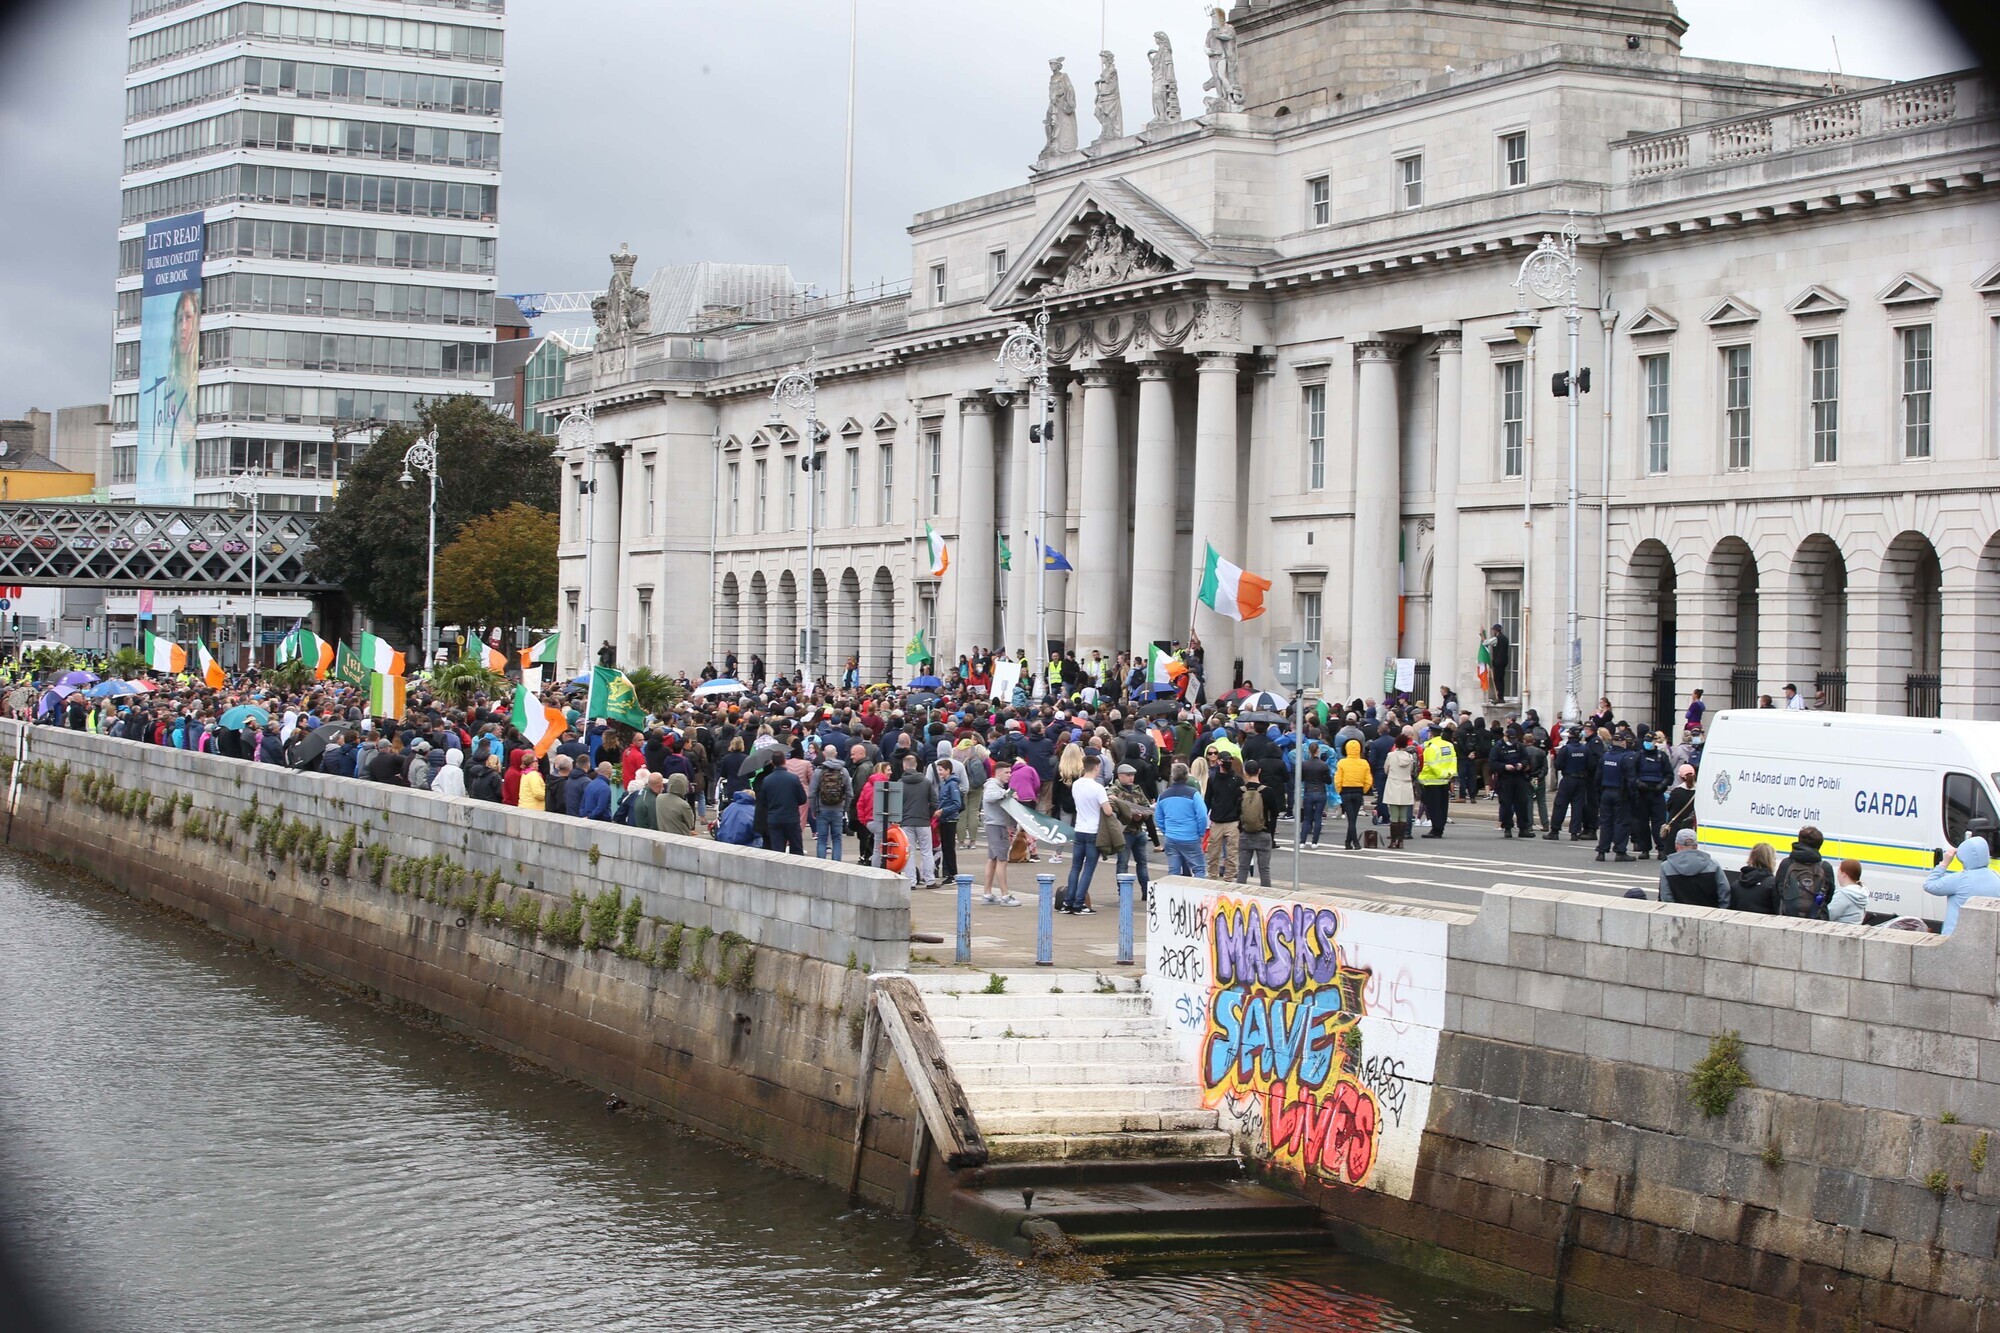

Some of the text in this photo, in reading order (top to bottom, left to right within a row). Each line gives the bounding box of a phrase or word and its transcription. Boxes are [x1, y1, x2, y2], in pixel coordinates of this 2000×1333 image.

[148, 225, 201, 251] LET'S READ!
[146, 249, 200, 270] DUBLIN ONE CITY
[155, 269, 188, 286] ONE BOOK
[1738, 769, 1750, 782] An
[1752, 771, 1782, 785] tAonad
[1783, 776, 1797, 786] um
[1799, 774, 1815, 788] Ord
[1750, 802, 1820, 821] Public Order Unit
[1854, 790, 1918, 818] GARDA
[1868, 891, 1900, 902] w.garda.ie
[1215, 904, 1337, 993] MASKS
[1205, 983, 1342, 1091] SAVE
[1269, 1078, 1375, 1184] LIVES
